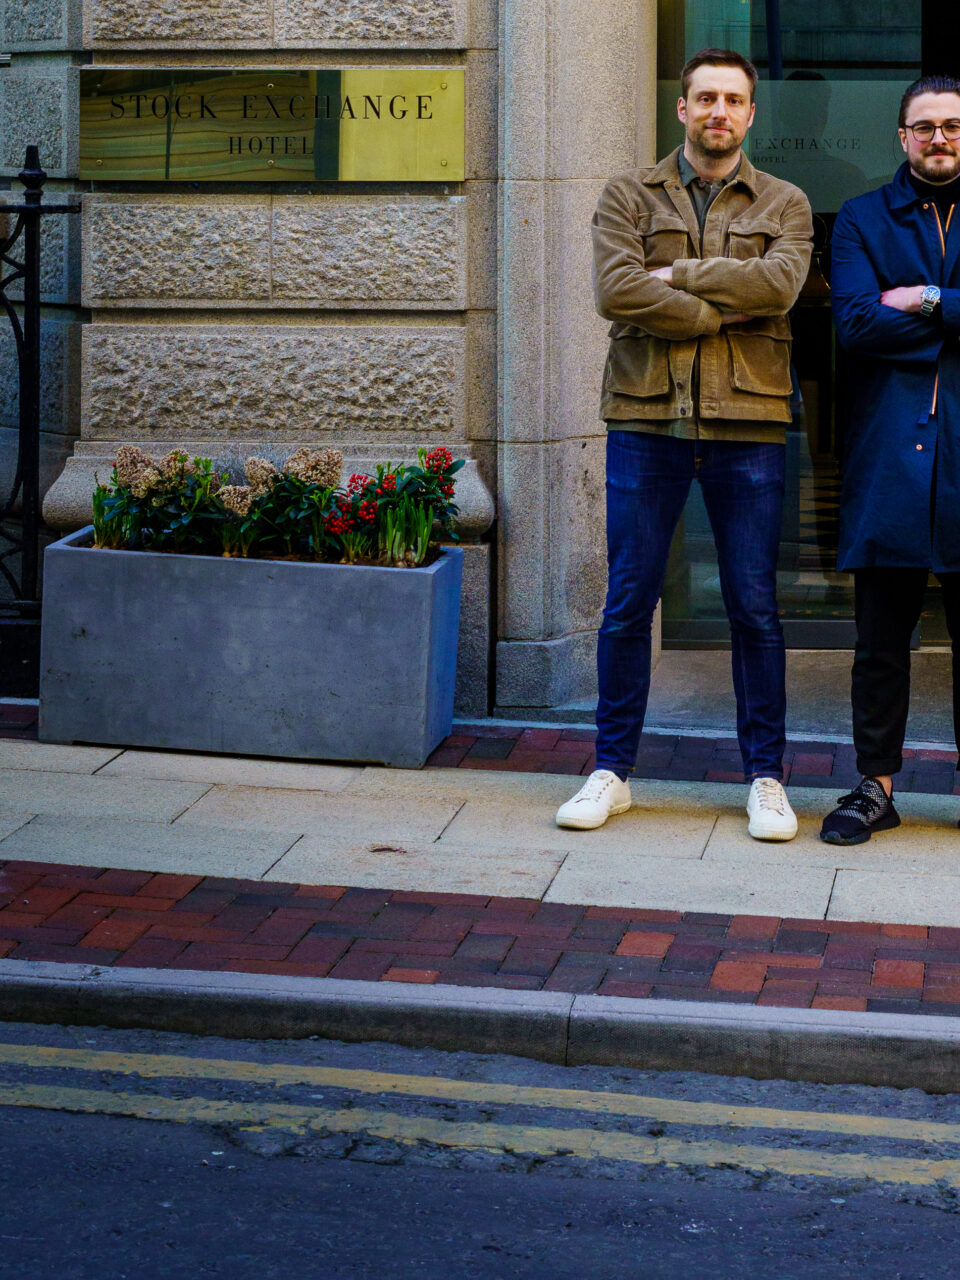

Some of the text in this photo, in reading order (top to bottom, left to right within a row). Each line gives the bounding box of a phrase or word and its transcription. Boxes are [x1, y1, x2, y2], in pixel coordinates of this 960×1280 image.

[110, 94, 434, 120] STOCK EXCHANGE
[228, 135, 314, 155] HOTEL
[754, 137, 861, 151] EXCHANGE
